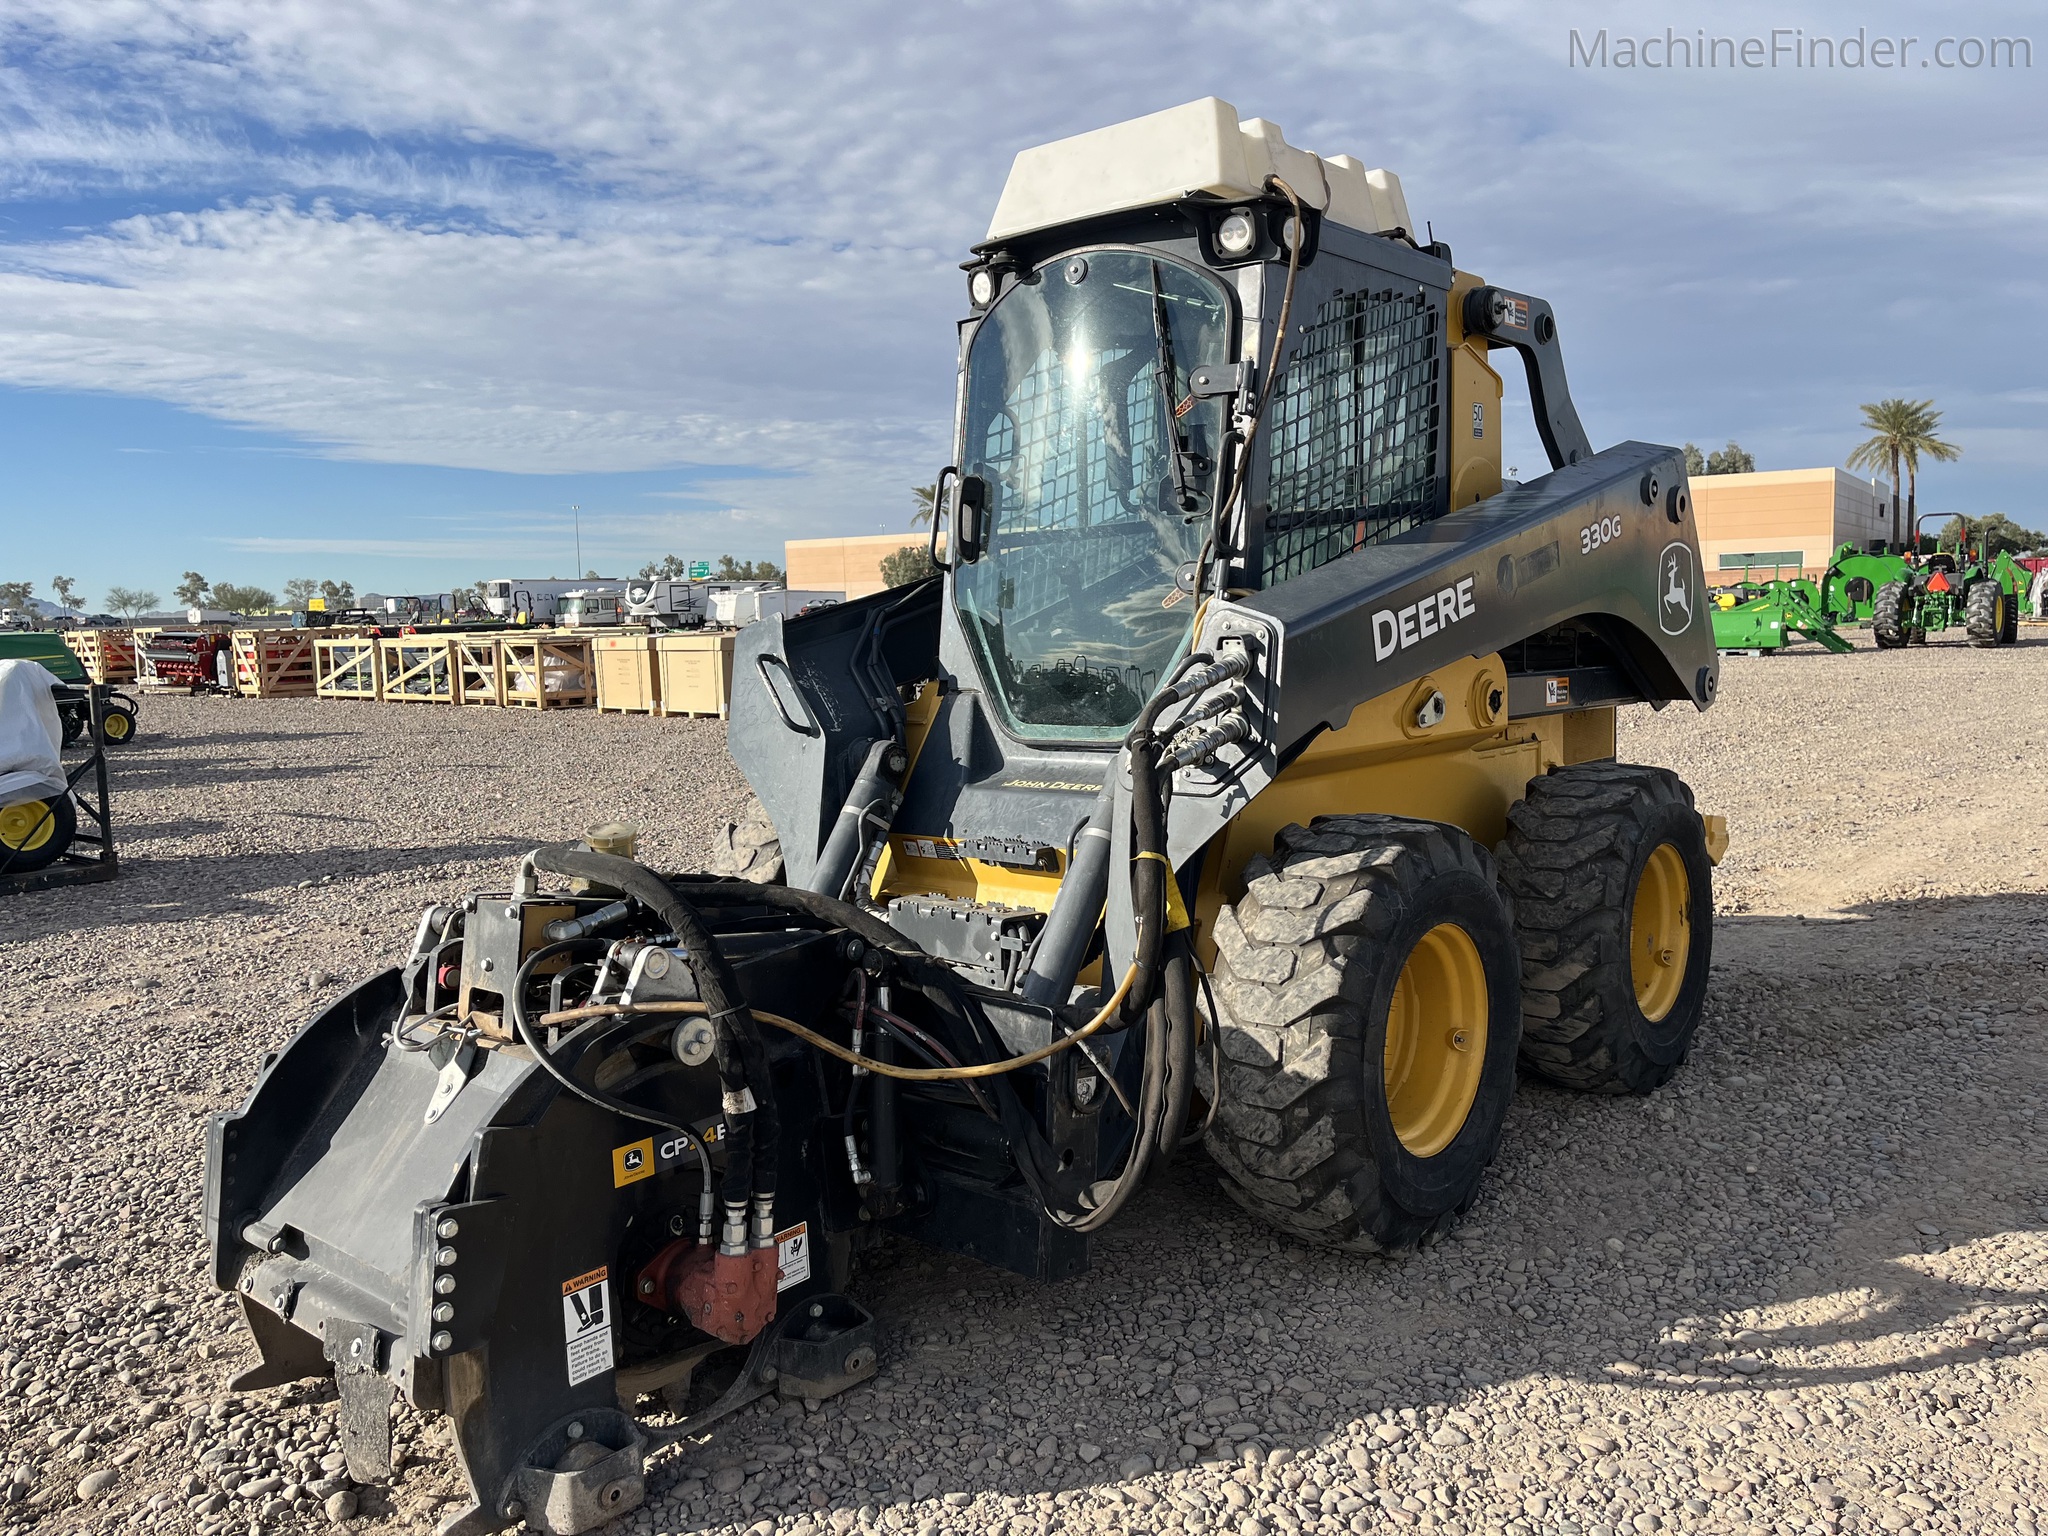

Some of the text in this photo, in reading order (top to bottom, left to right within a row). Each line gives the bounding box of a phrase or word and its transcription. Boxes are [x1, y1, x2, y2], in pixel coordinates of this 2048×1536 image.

[1473, 404, 1483, 422] 50
[1580, 514, 1622, 555] 330G
[1371, 576, 1476, 663] DEERE
[1001, 779, 1103, 791] JOHN DEERE
[660, 1123, 726, 1159] CP4E
[572, 1269, 606, 1288] WARNING
